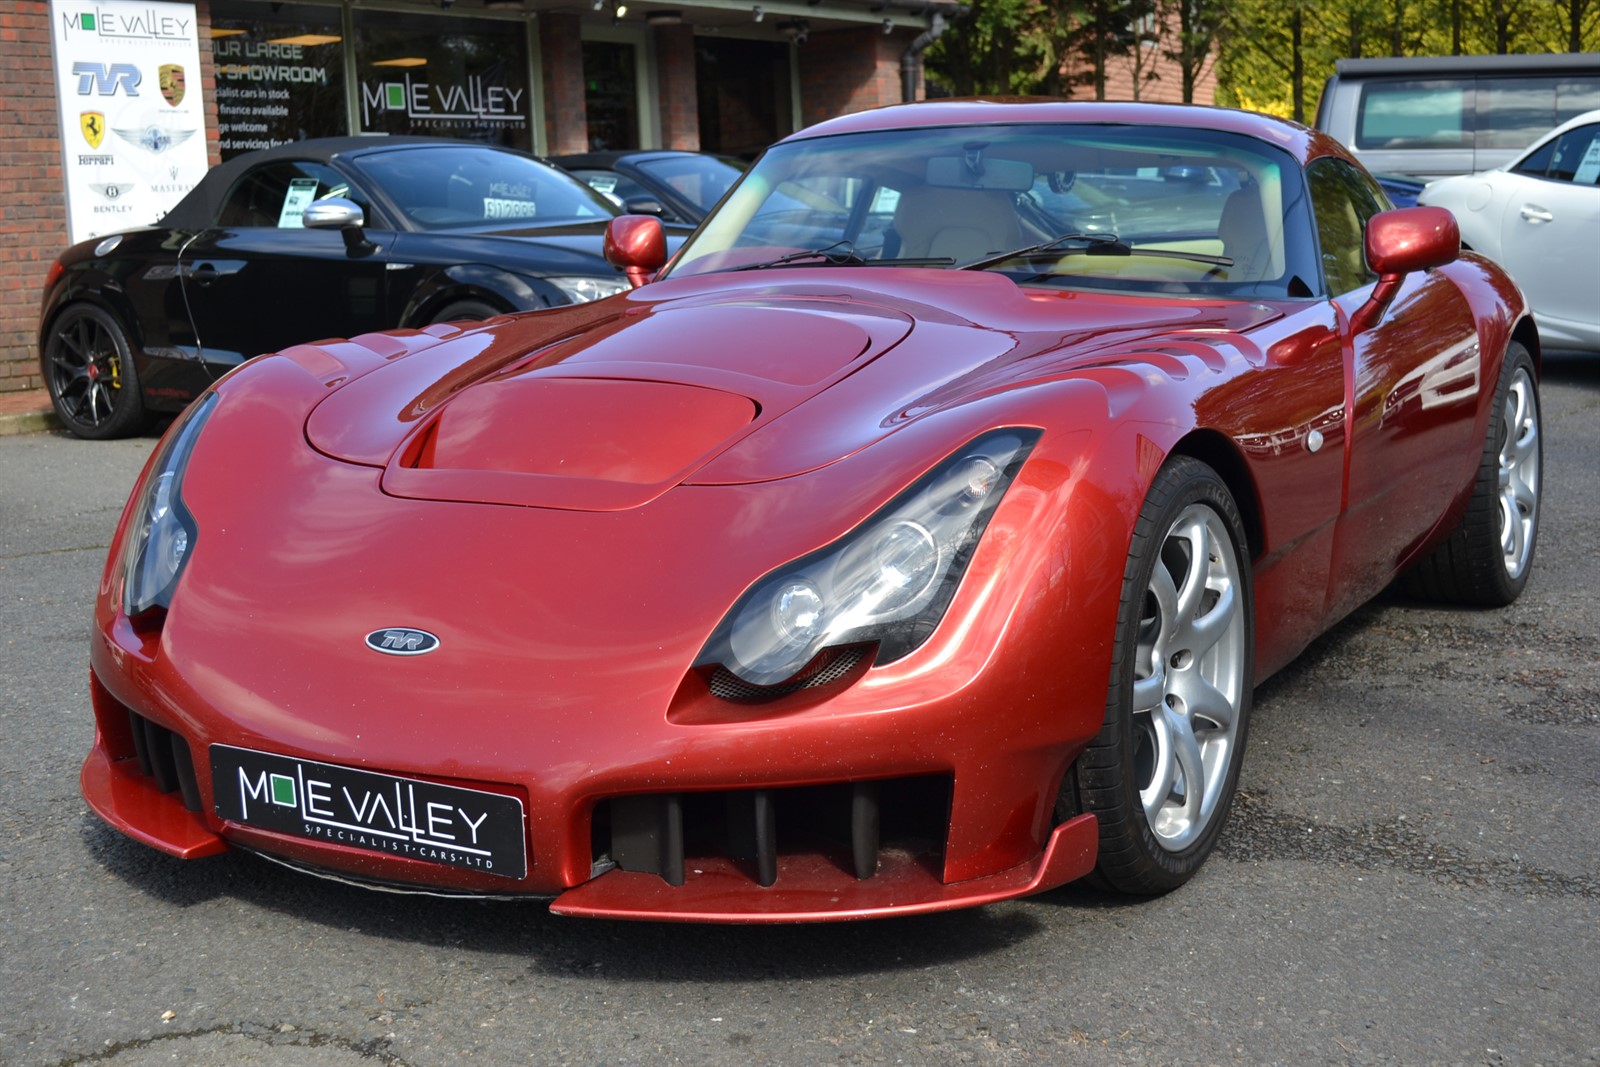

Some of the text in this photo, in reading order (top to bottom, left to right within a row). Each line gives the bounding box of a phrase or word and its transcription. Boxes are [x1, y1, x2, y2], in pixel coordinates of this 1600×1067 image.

[63, 6, 190, 41] MOLE VALLEY
[245, 41, 303, 59] LARGE
[72, 62, 142, 96] TVR
[226, 64, 326, 82] SHOWROOM
[241, 90, 257, 98] cars
[258, 88, 267, 98] in
[268, 89, 290, 99] stock
[362, 72, 525, 126] MOLE VALLEY
[220, 104, 288, 116] finance available
[230, 121, 268, 132] welcome
[232, 138, 269, 150] servicing
[78, 154, 114, 165] Ferrari
[94, 205, 133, 213] BENTLEY
[381, 630, 423, 650] TVR
[238, 764, 491, 856] MOLE VALLEY
